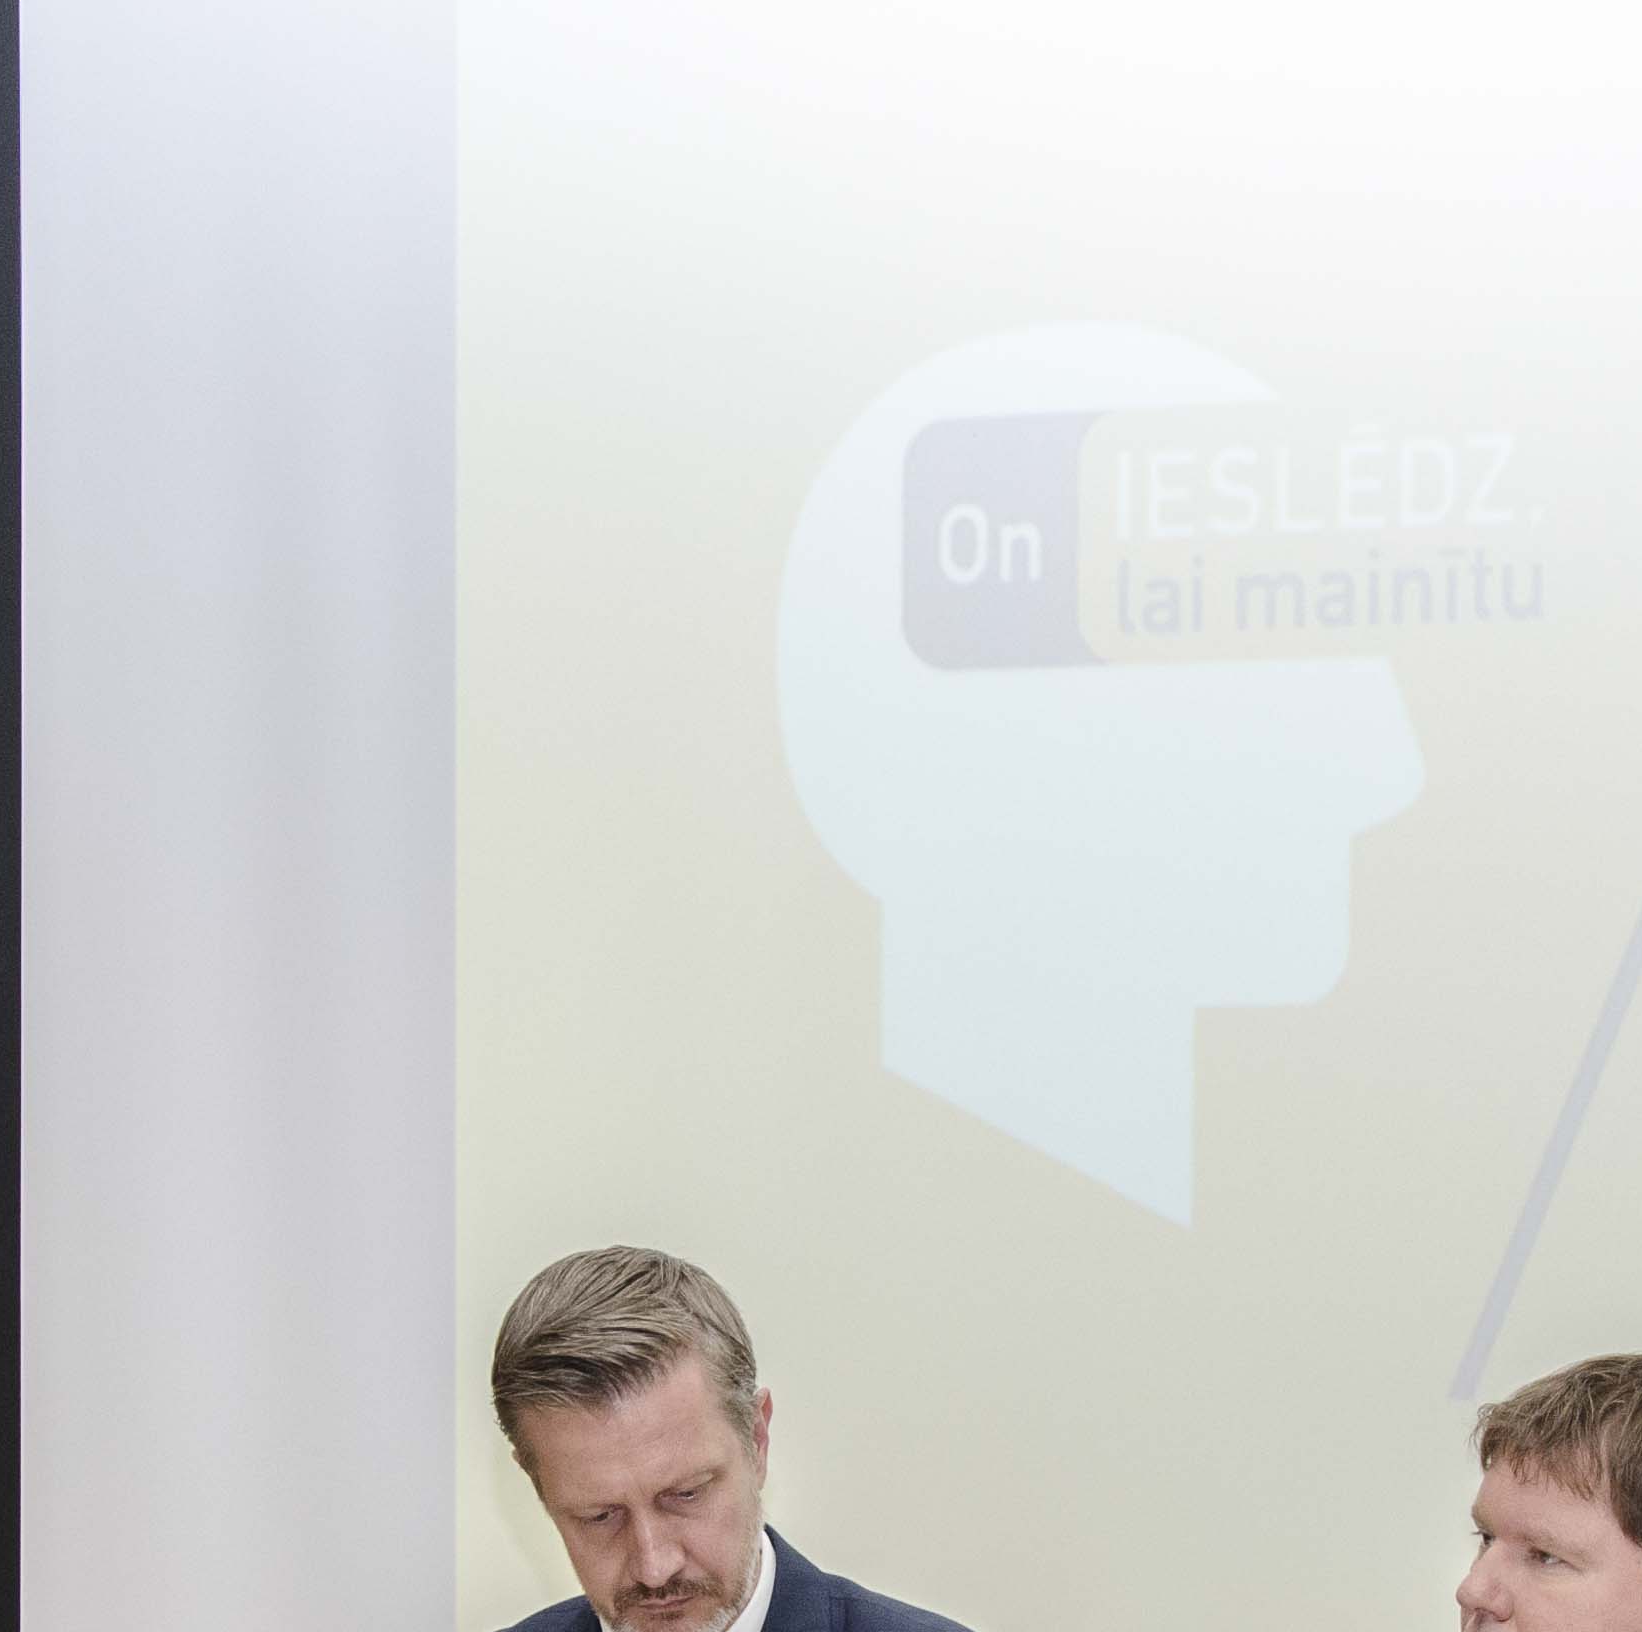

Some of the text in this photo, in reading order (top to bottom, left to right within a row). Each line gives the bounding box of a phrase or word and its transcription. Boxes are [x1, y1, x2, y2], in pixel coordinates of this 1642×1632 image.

[939, 502, 1043, 584] On
[1118, 547, 1546, 636] lai mainītu
